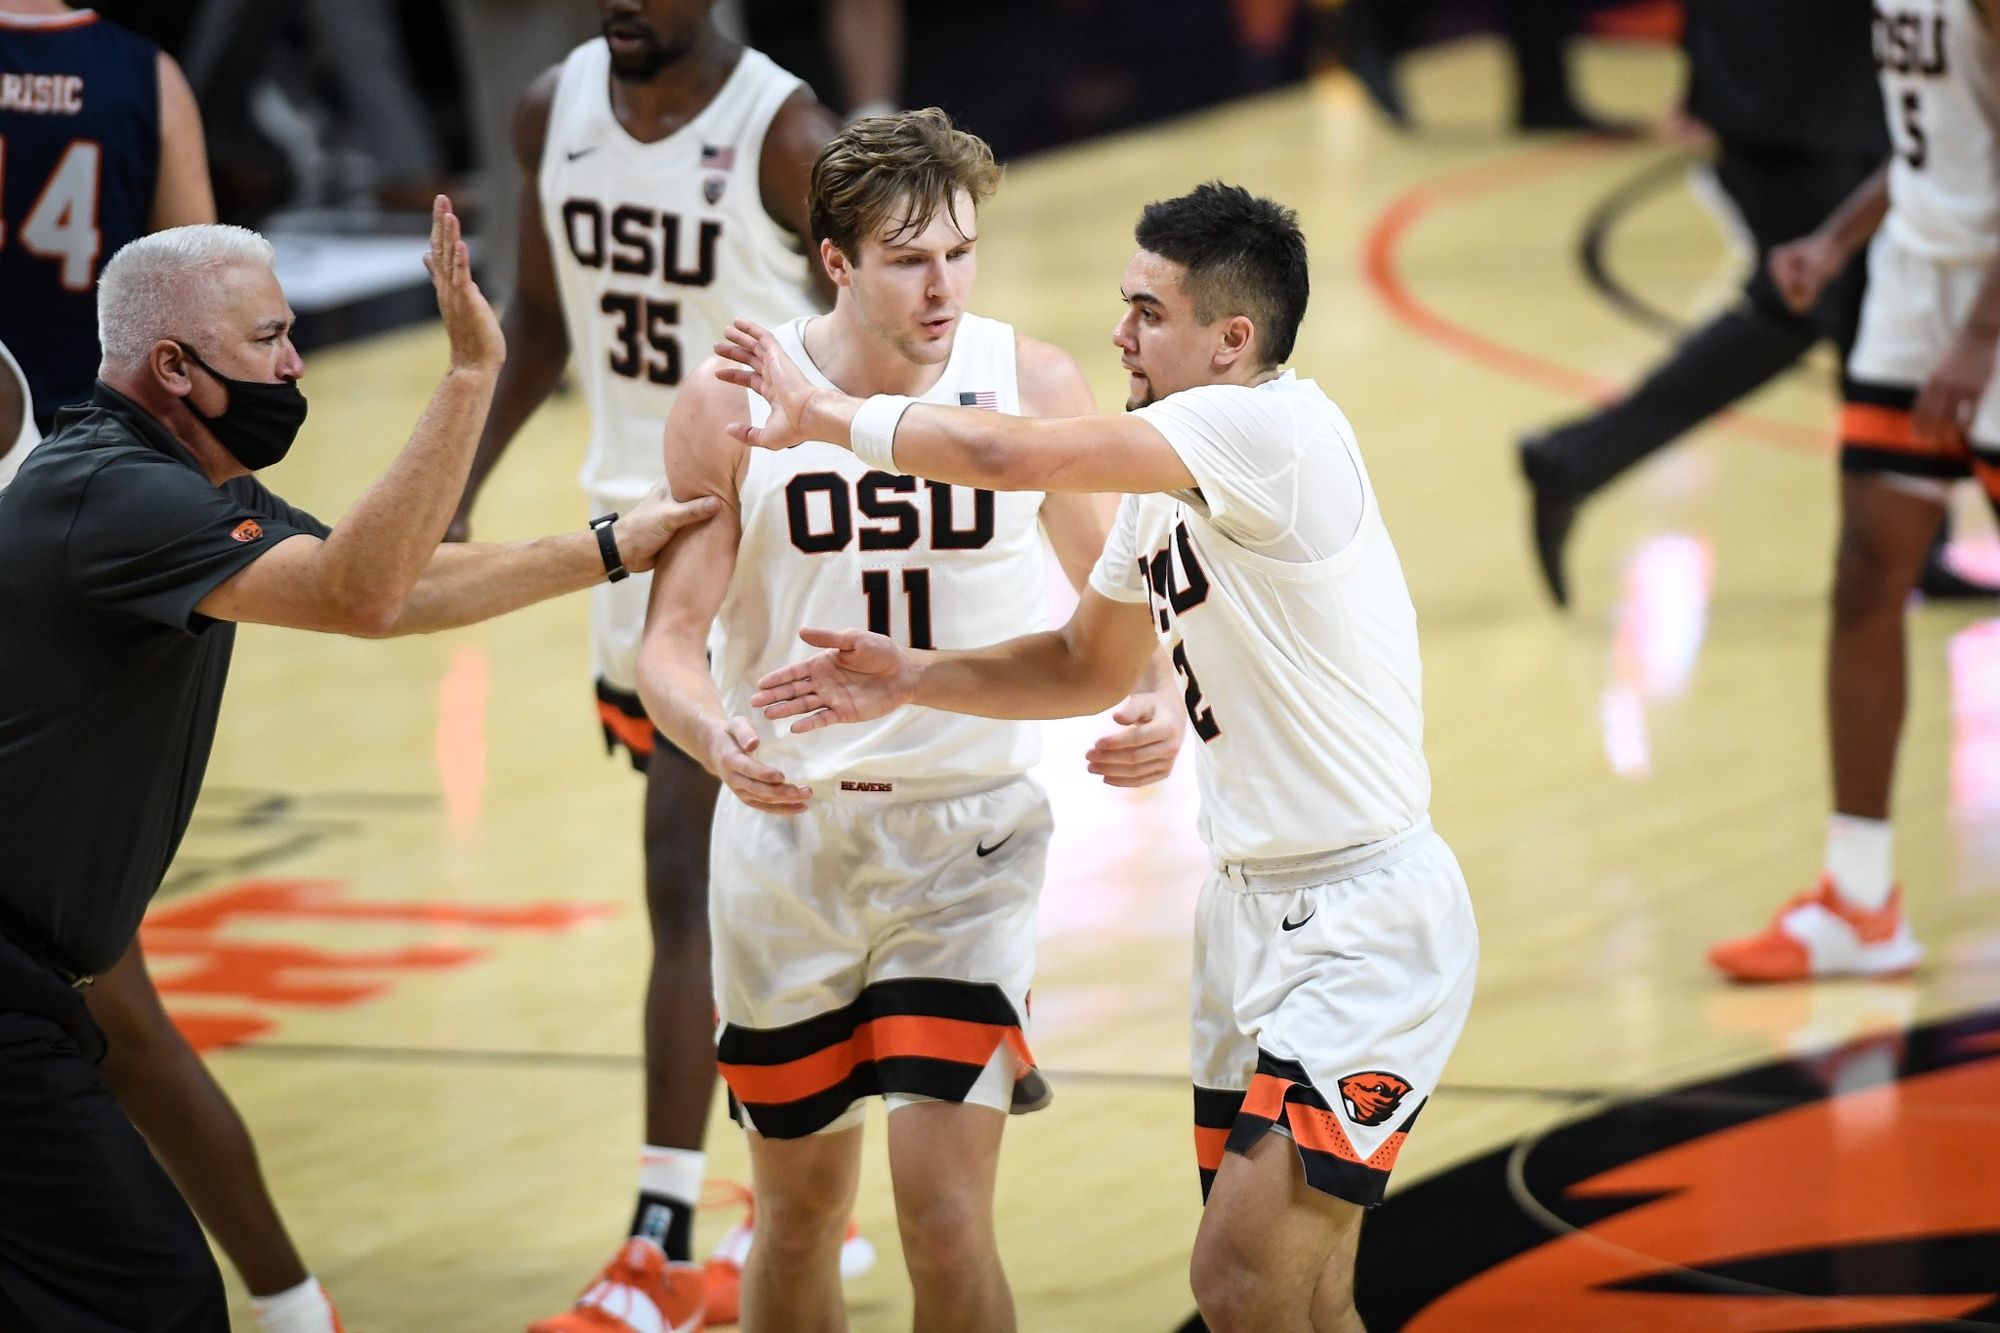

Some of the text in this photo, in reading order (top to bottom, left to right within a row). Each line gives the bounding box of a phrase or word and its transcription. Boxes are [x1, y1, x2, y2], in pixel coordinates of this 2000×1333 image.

[0, 73, 84, 115] RISIC
[0, 133, 102, 292] 4
[562, 198, 722, 287] OSU
[601, 293, 682, 386] 35
[785, 470, 995, 555] OSU
[861, 567, 937, 650] 11
[1172, 638, 1222, 744] 2
[841, 781, 893, 792] BEAVERS
